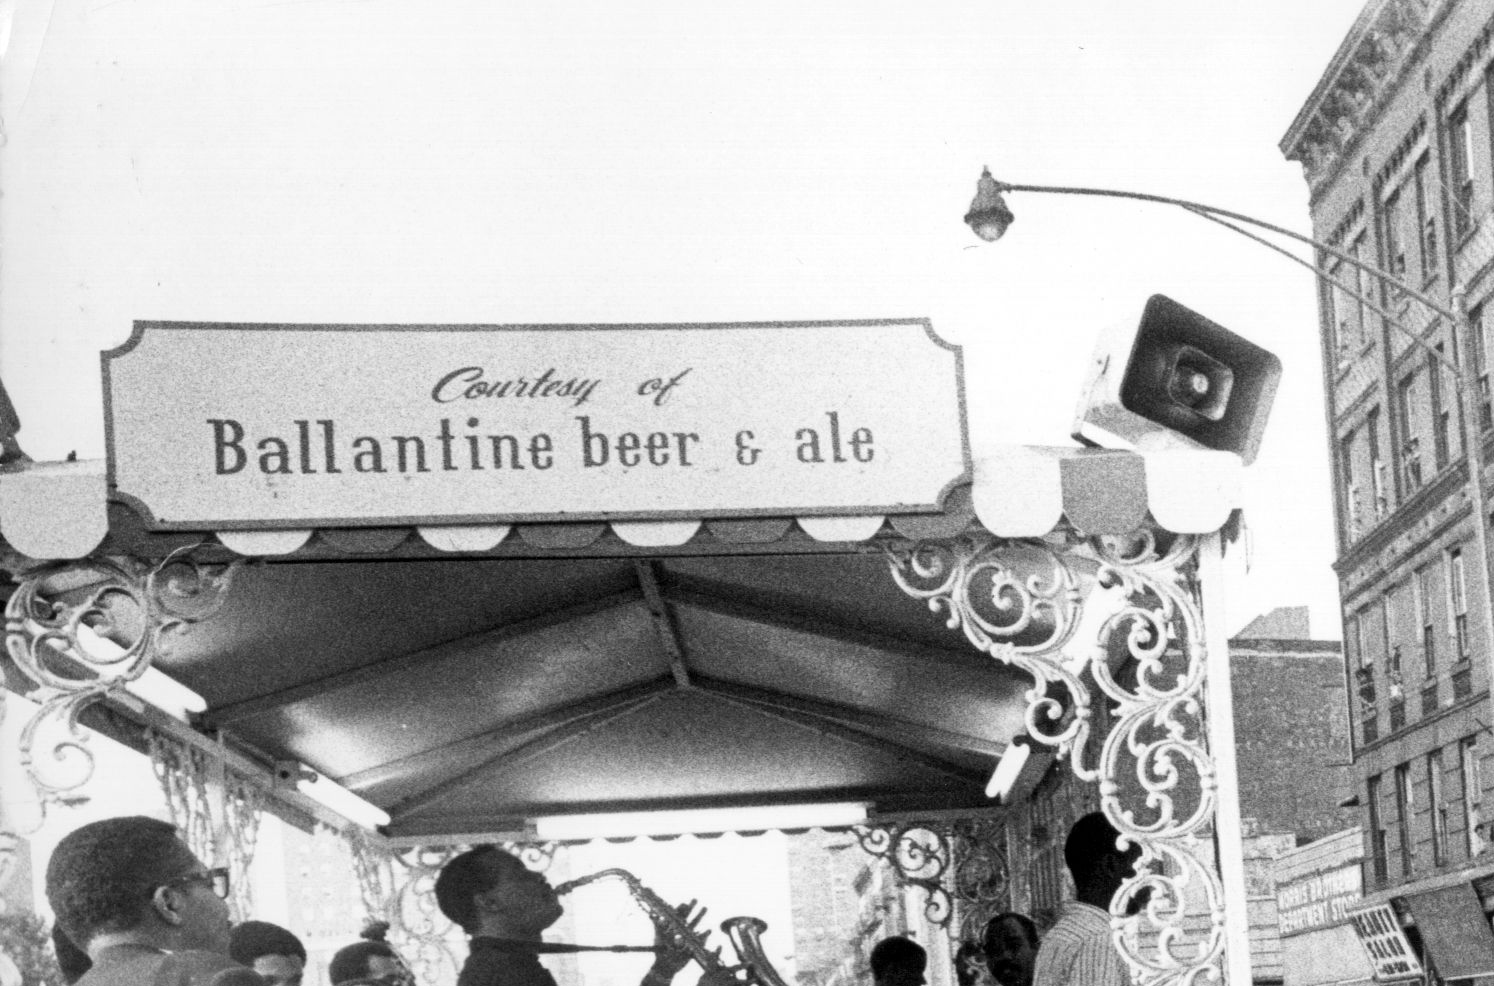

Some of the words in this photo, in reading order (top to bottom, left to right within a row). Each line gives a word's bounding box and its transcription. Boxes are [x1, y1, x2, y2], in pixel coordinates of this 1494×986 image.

[431, 366, 601, 407] Courtesy
[637, 367, 693, 406] of
[206, 416, 553, 476] Ballantine
[574, 415, 700, 468] beer
[734, 430, 763, 466] &
[794, 410, 875, 464] ale
